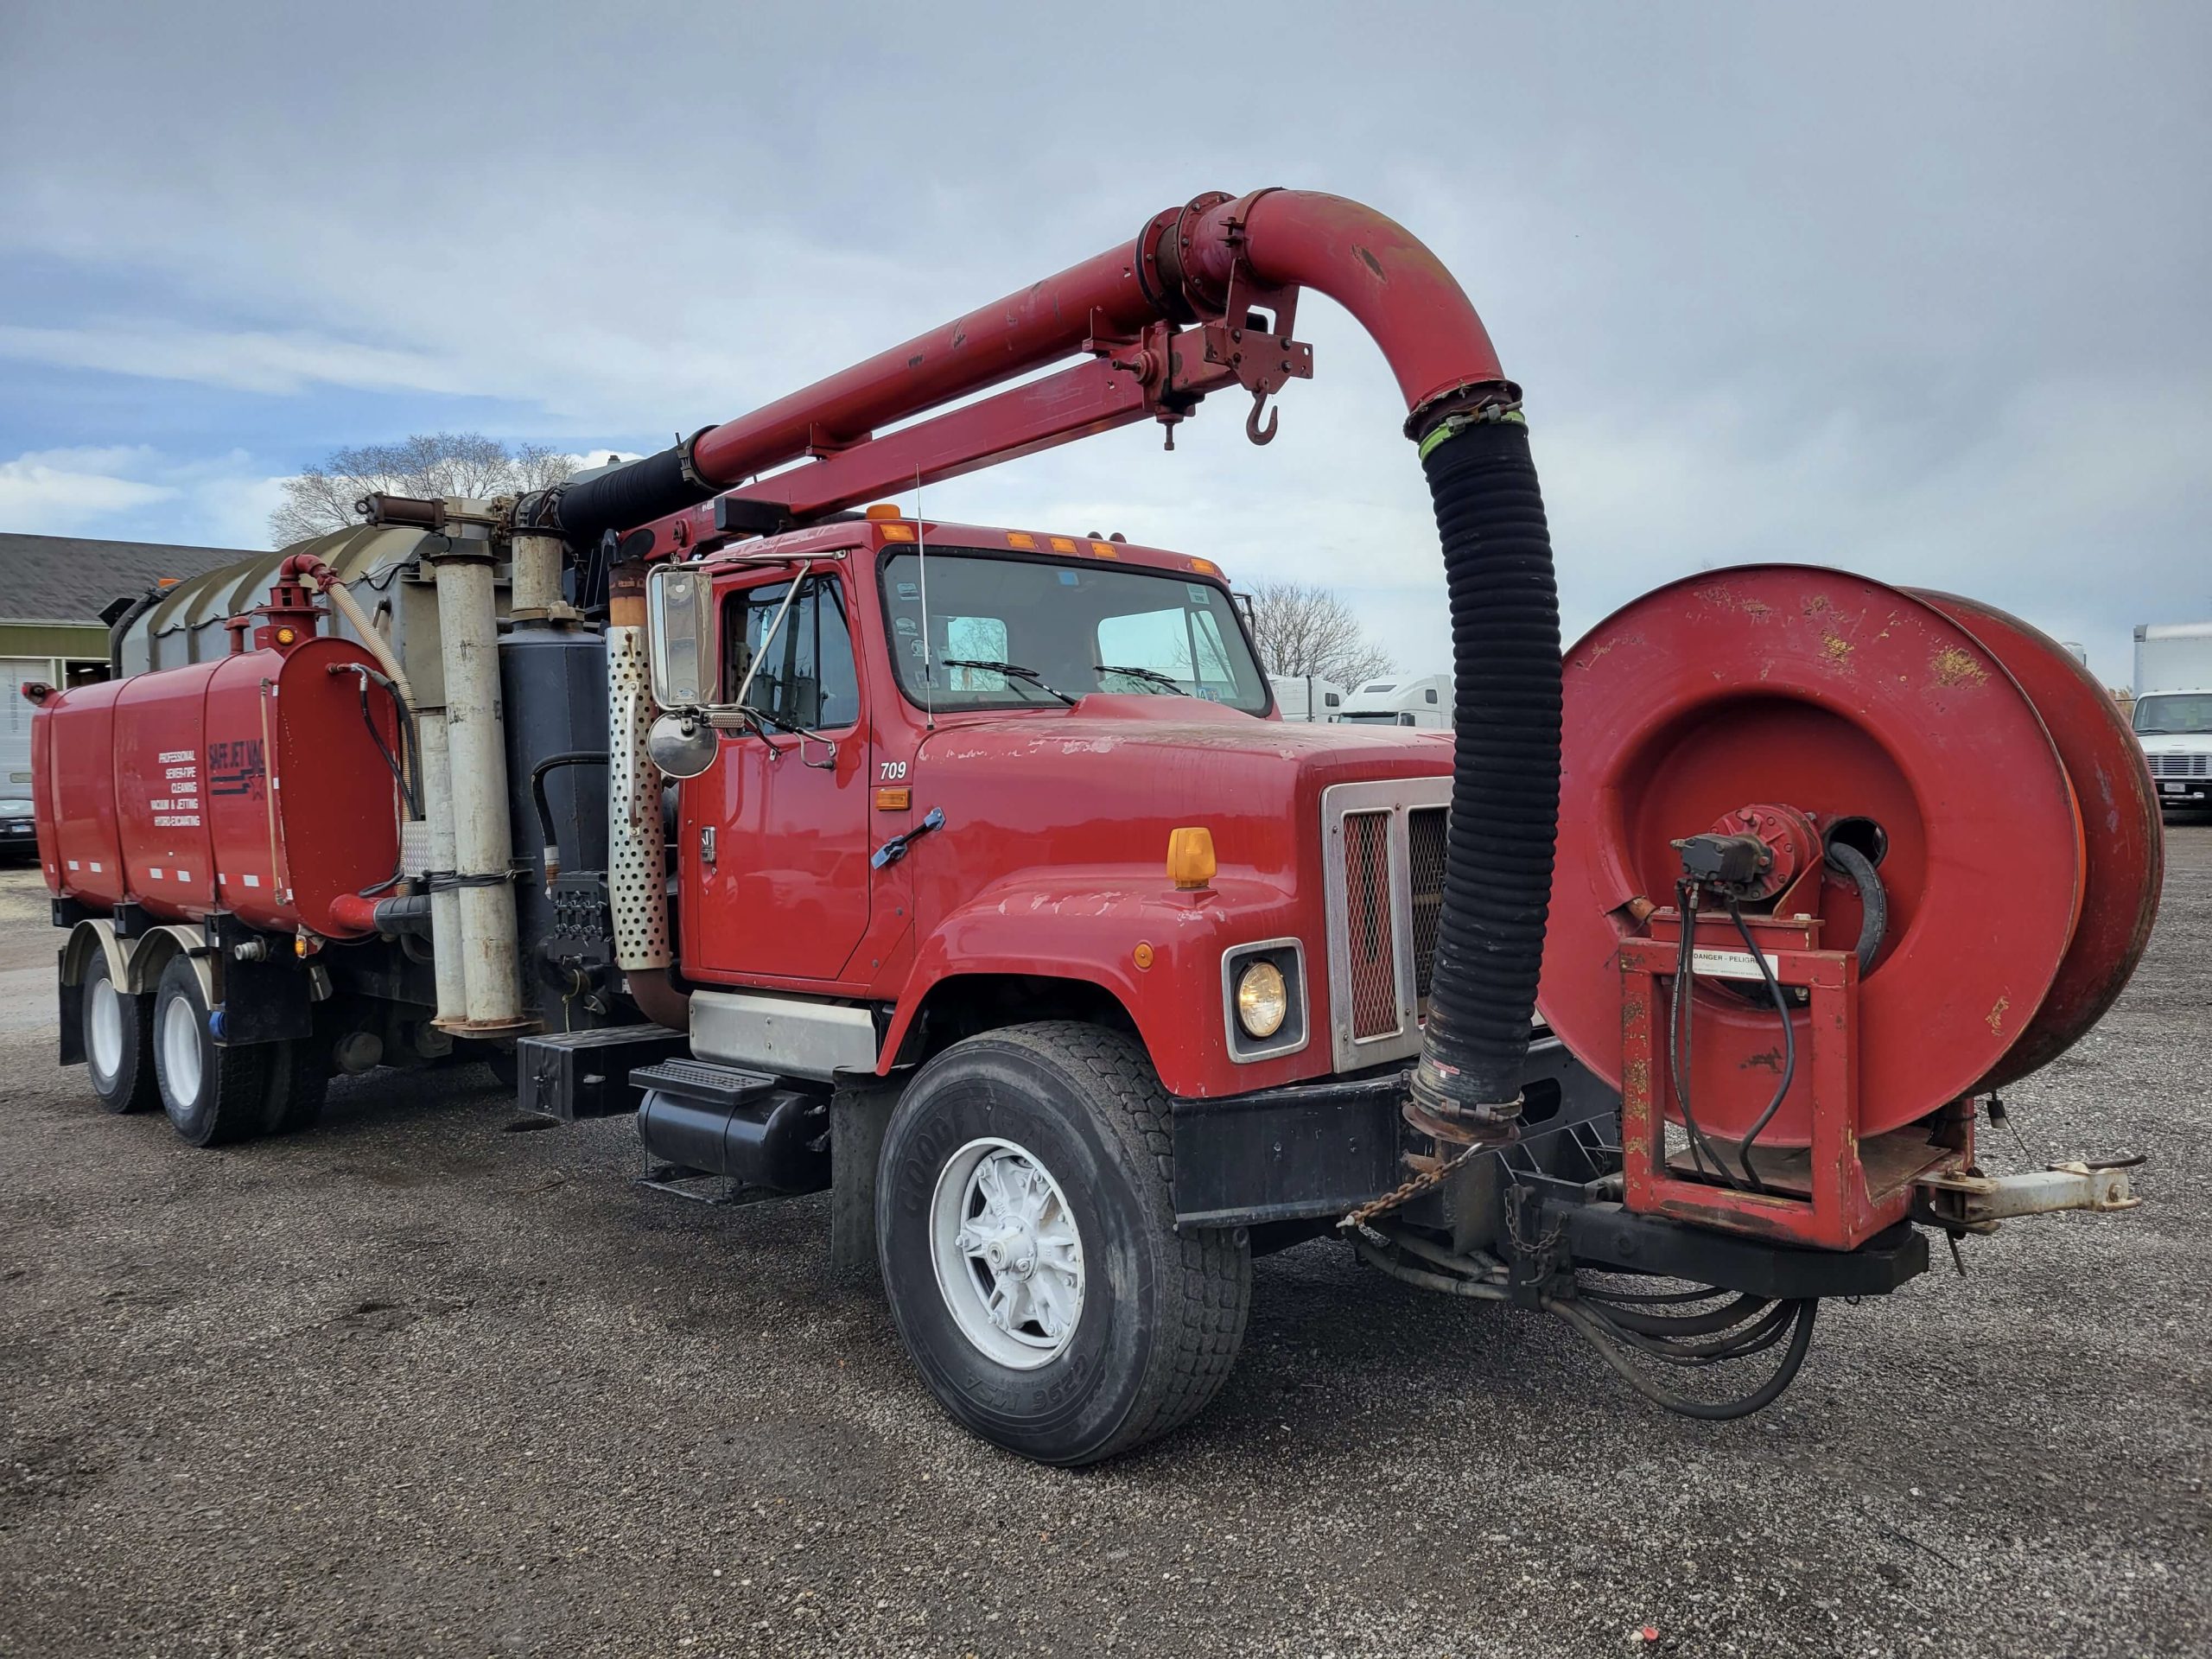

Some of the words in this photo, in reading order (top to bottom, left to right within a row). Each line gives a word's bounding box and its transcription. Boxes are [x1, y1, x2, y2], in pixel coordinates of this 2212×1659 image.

[158, 750, 196, 763] PROFESSIONAL
[209, 743, 228, 770] SAFE
[231, 741, 245, 767] JET
[165, 766, 196, 779] SEWER-PIPE
[880, 761, 906, 780] 709
[172, 782, 197, 793] CLEANING
[176, 798, 199, 810] JETTING
